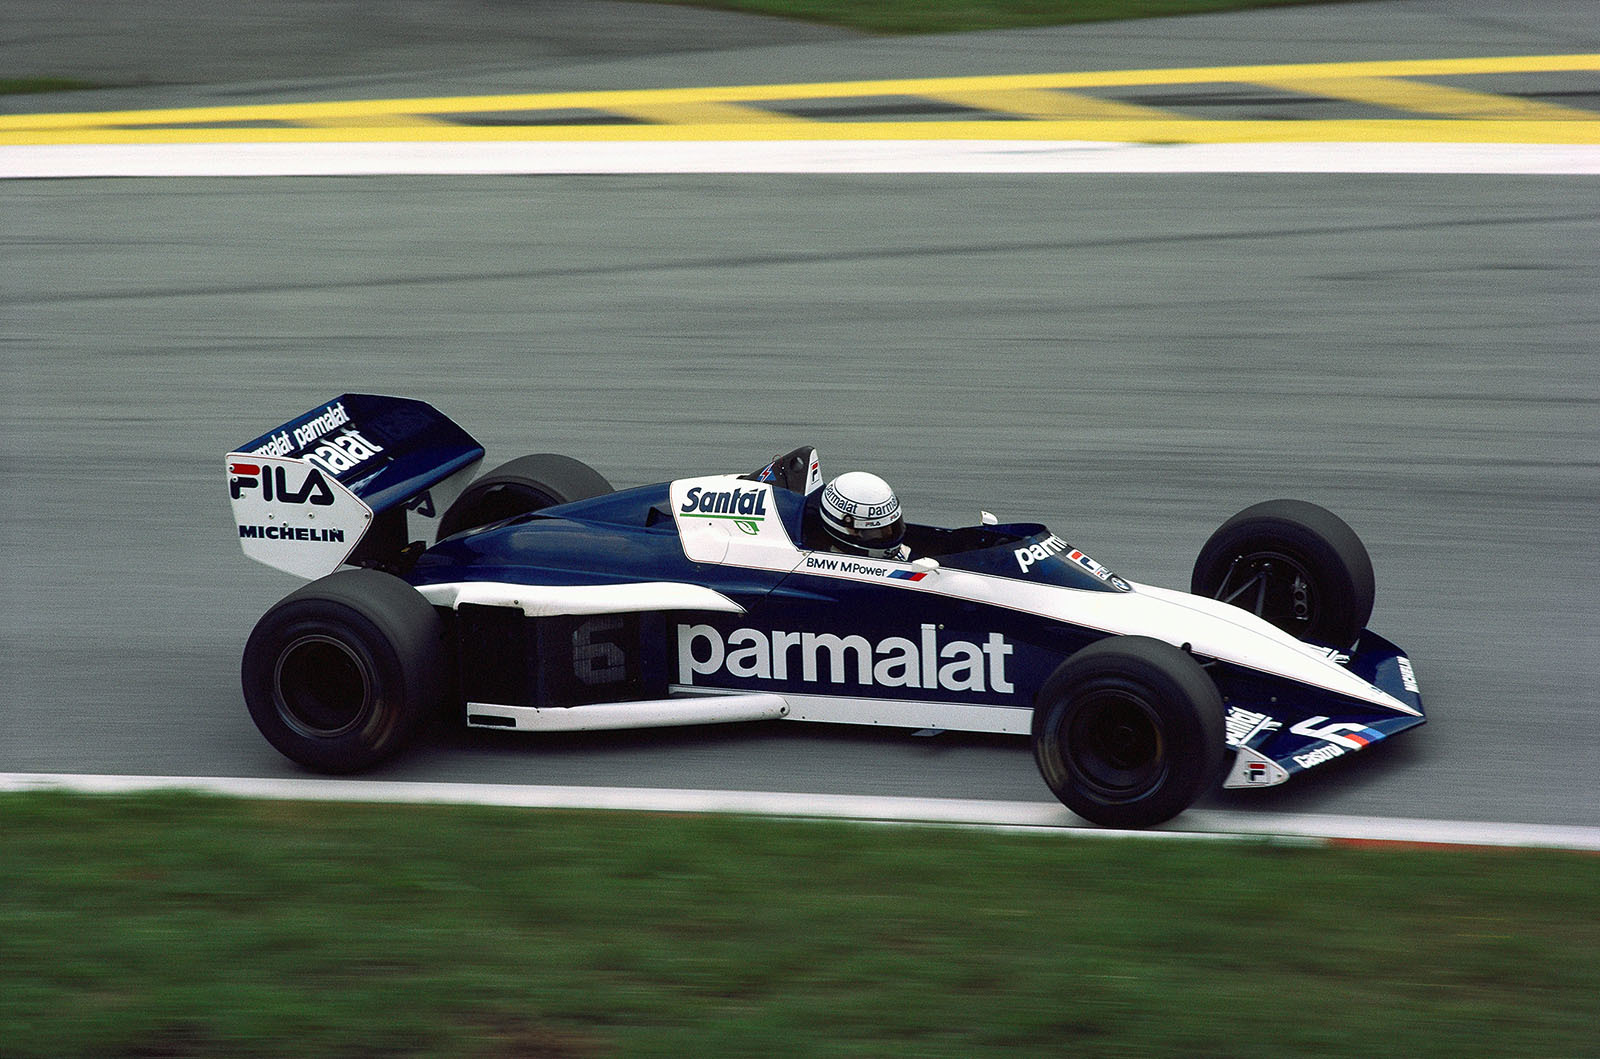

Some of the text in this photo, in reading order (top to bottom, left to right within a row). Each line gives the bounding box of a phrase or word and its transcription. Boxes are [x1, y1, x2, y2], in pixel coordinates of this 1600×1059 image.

[252, 402, 350, 456] malat parmalat
[228, 463, 335, 506] FILA
[239, 525, 344, 543] MICHELIN
[806, 557, 838, 571] BMW
[572, 618, 625, 685] 6
[677, 623, 1015, 694] parmalat
[1292, 743, 1346, 769] Castrol
